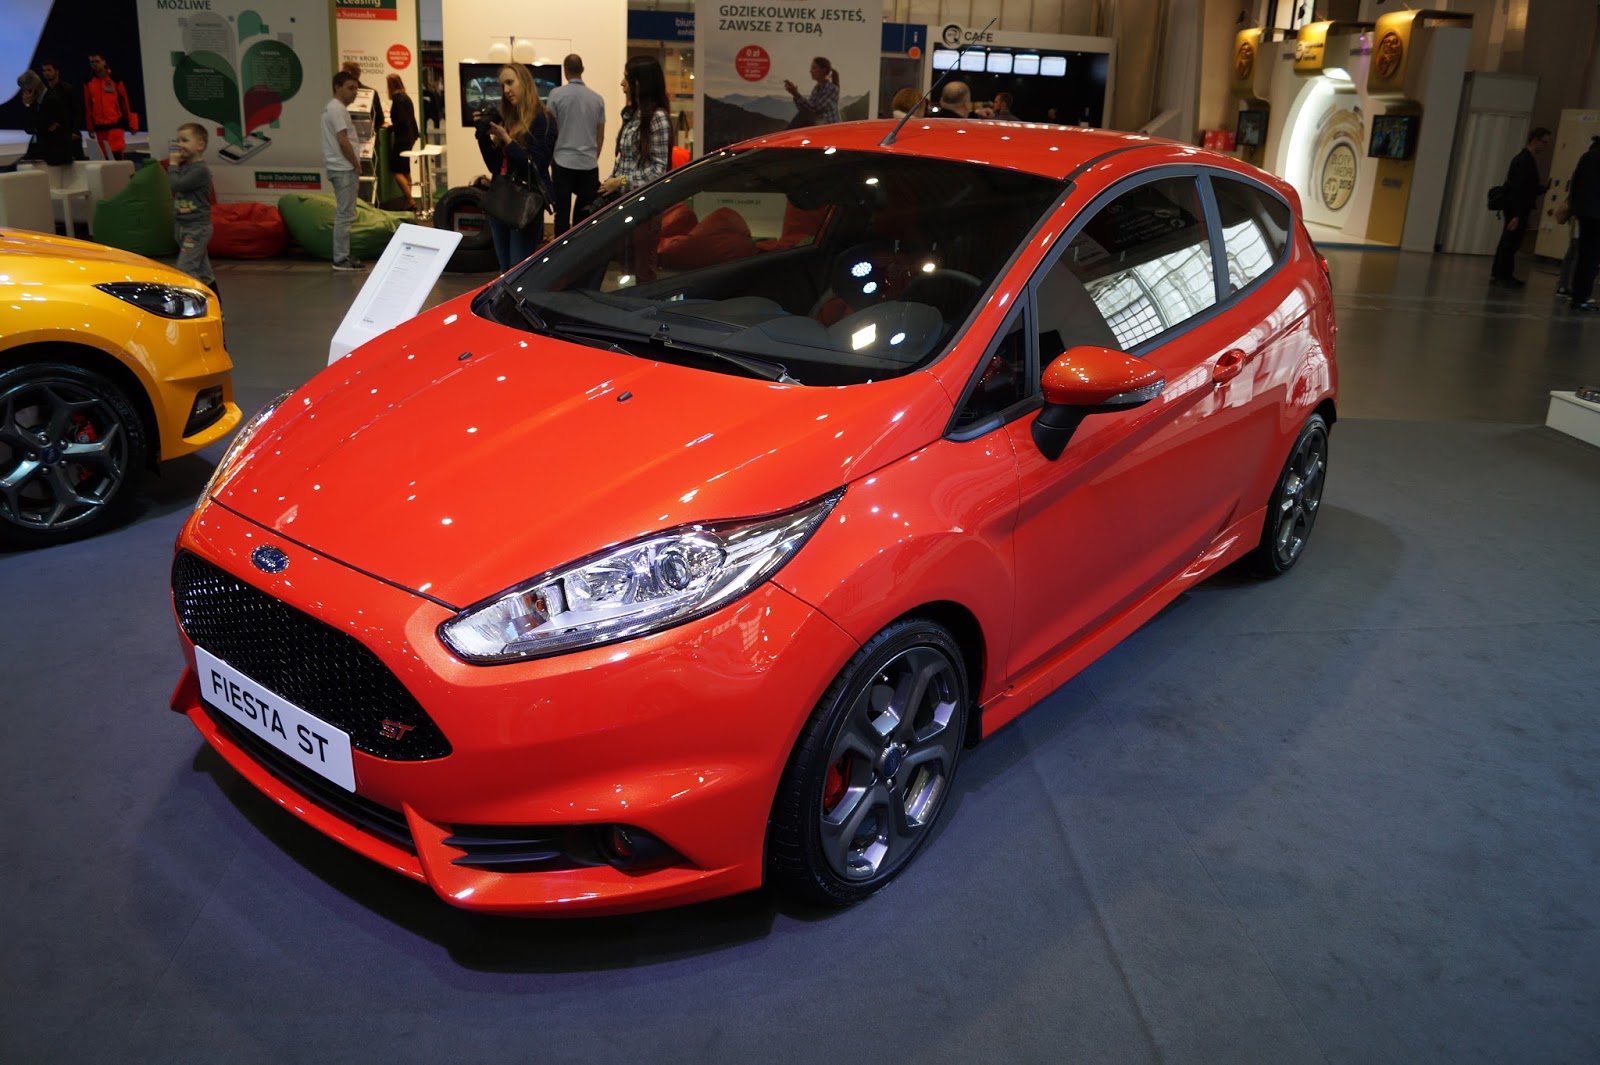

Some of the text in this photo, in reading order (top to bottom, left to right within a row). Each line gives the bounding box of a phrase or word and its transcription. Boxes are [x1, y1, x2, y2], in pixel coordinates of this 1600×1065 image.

[719, 5, 866, 23] GDZIEKOLWIEK JESTEŚ,
[719, 19, 823, 36] ZAWSZE Z TOBĄ
[210, 668, 329, 763] FIESTA ST
[379, 719, 415, 741] ST
